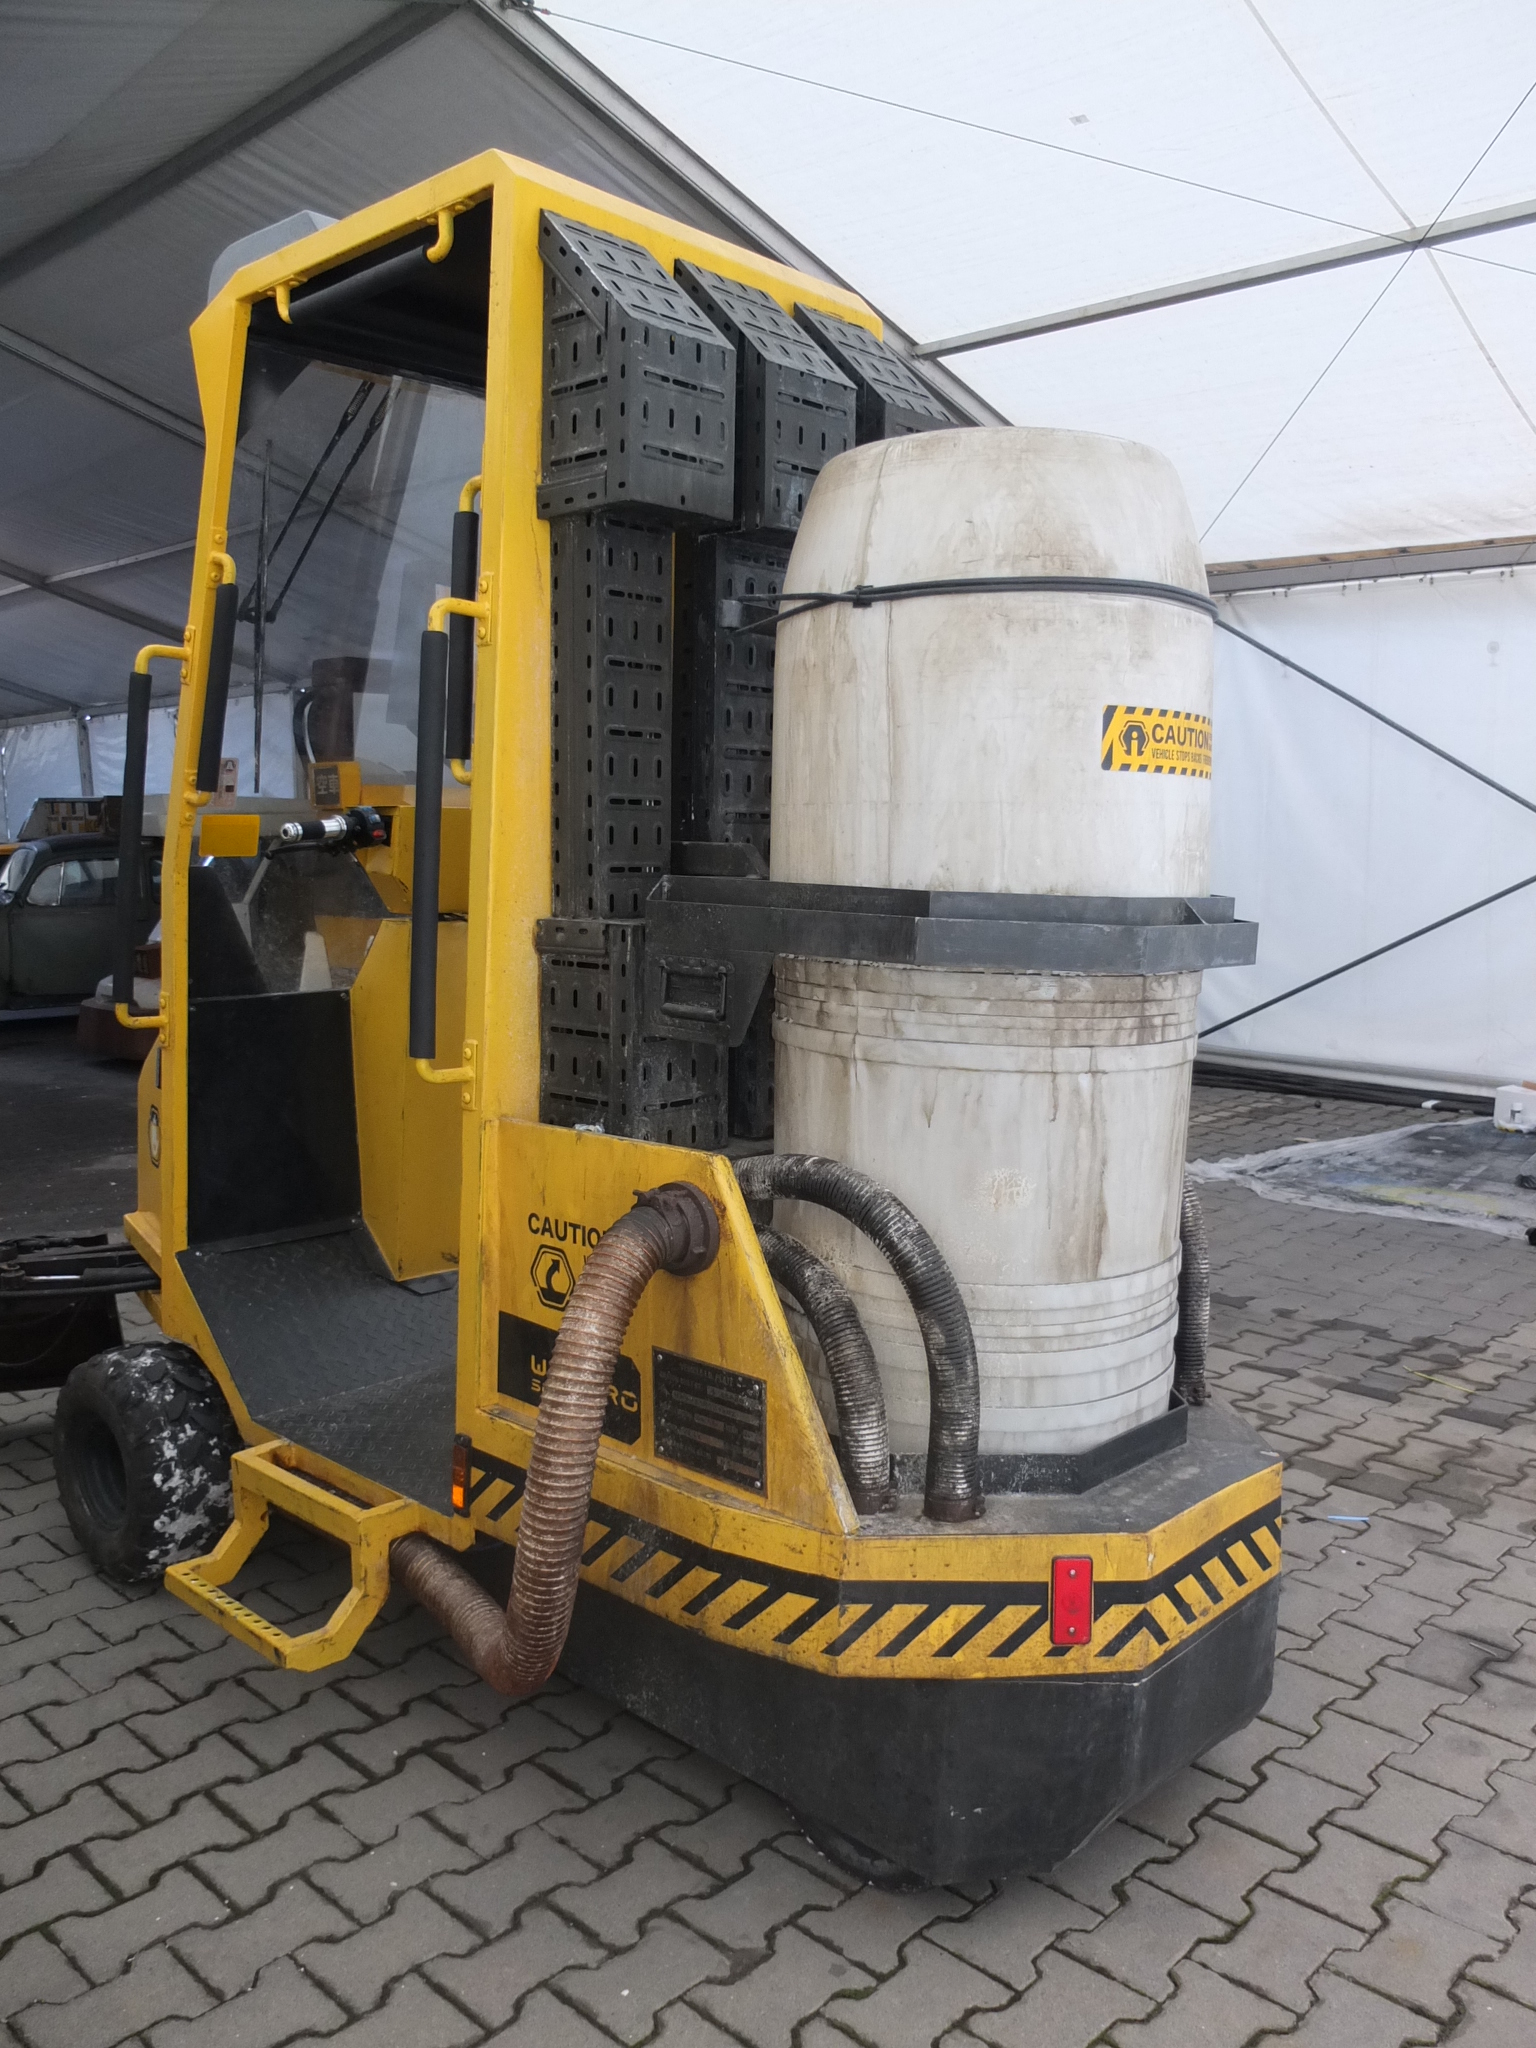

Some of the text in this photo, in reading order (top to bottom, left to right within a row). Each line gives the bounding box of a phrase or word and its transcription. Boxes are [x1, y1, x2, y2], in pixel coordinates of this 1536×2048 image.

[1151, 723, 1209, 751] CAUTION
[1151, 748, 1175, 761] VEHICLE
[1176, 750, 1191, 763] STOPS
[527, 1212, 607, 1250] CAUTIO
